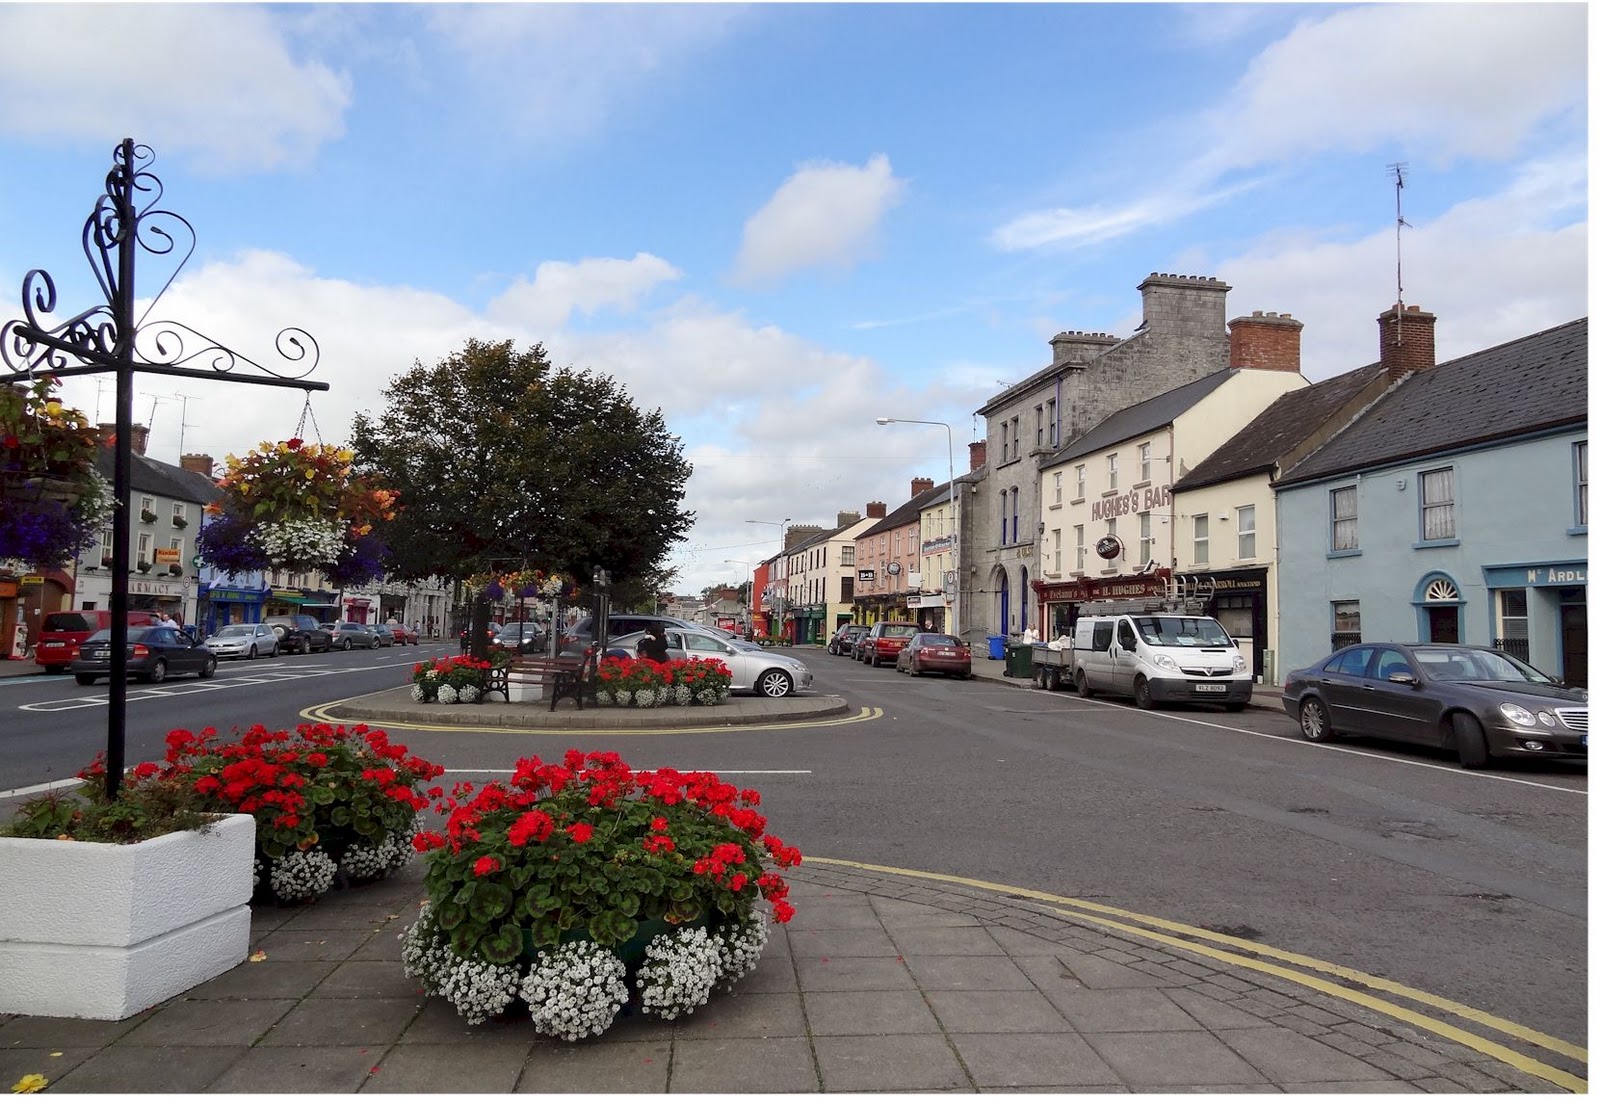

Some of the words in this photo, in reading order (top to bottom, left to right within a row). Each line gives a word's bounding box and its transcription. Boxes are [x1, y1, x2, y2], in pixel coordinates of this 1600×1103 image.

[1092, 489, 1139, 521] HUGHES'S
[1144, 485, 1172, 510] BAR
[1548, 568, 1587, 582] ARDL
[129, 582, 169, 594] ARMACY
[1112, 584, 1146, 596] HUGHES
